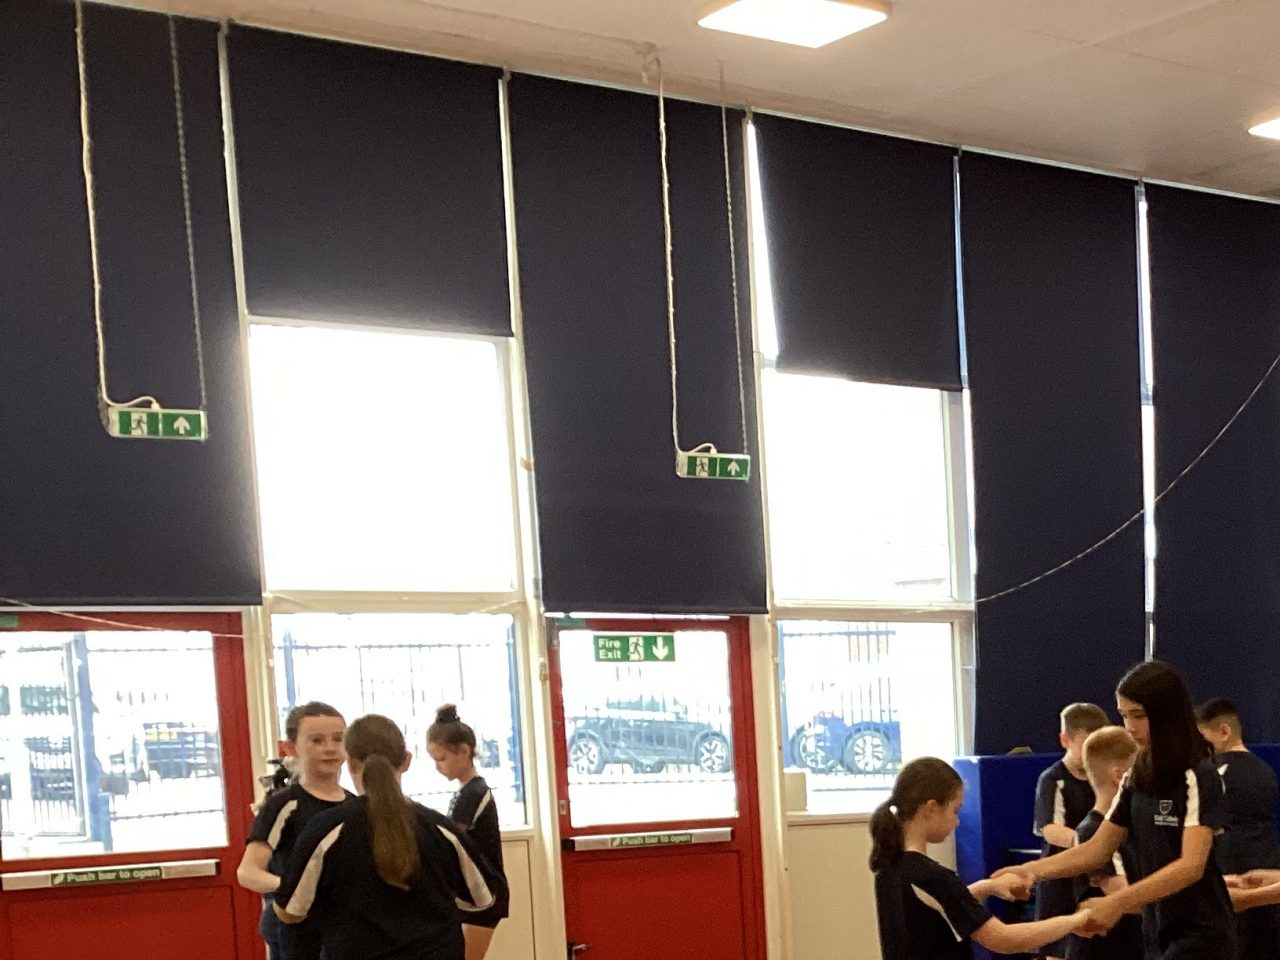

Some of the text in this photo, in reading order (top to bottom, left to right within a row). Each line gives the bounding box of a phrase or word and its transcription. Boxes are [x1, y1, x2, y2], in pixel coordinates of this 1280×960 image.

[598, 638, 621, 648] Fire
[599, 649, 622, 659] Exit
[670, 834, 691, 843] open
[67, 868, 160, 882] Push bar to open
